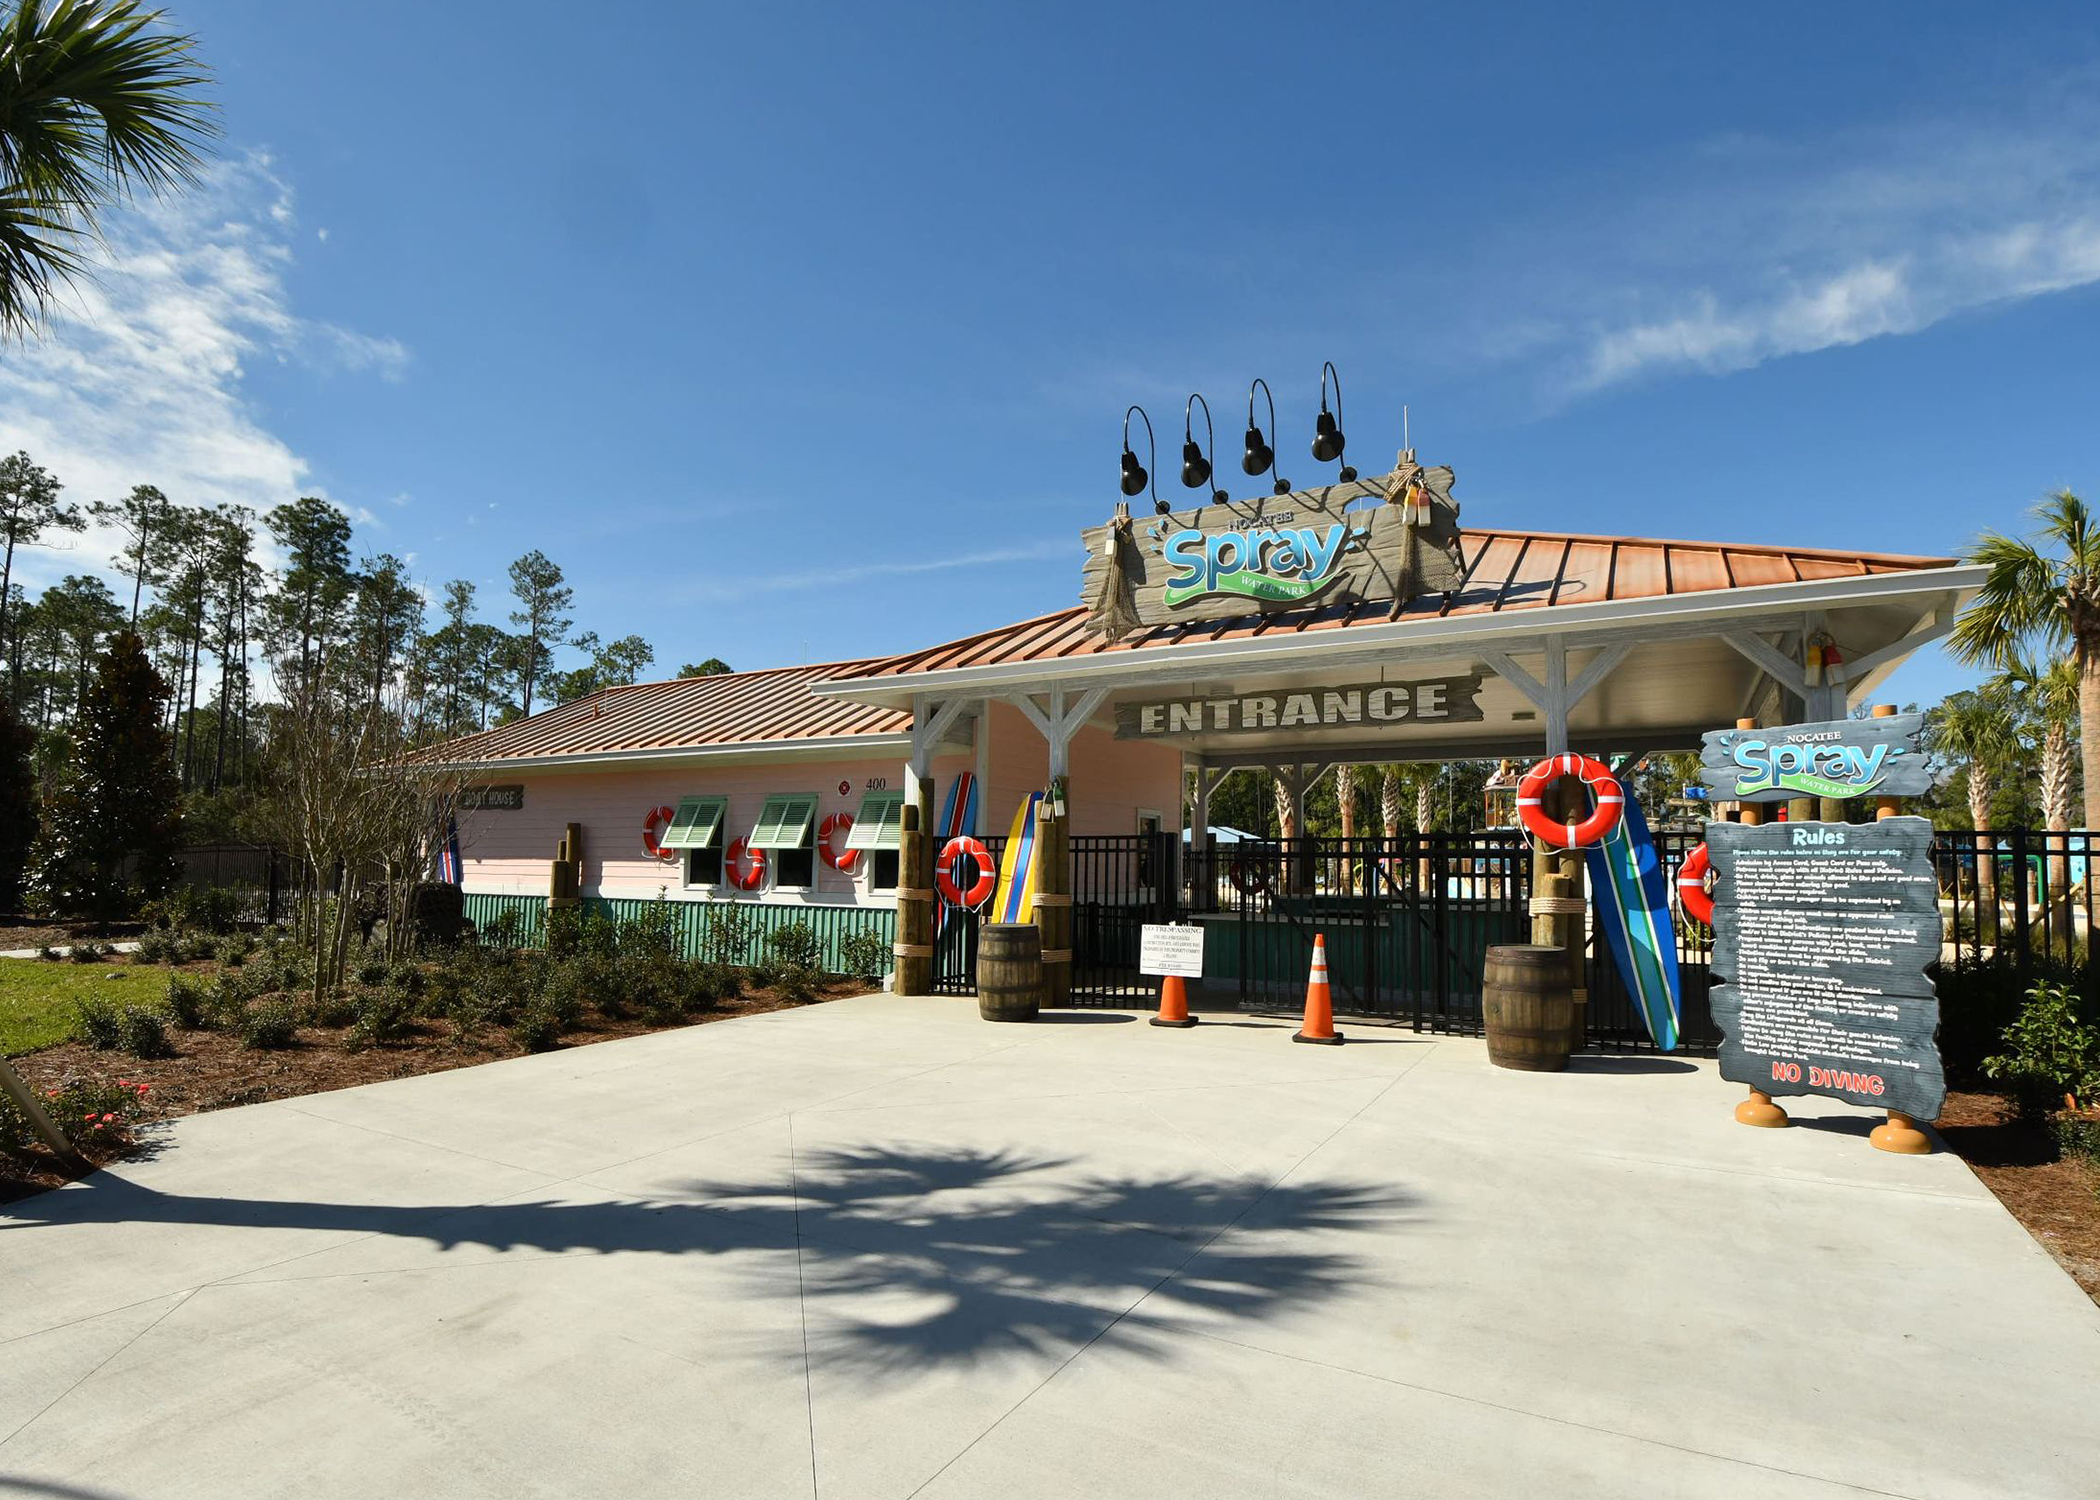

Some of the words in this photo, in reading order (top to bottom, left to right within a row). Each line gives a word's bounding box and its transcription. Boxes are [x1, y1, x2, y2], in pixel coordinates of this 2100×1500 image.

[1163, 523, 1347, 591] Spray
[1241, 575, 1276, 594] WATER
[1279, 585, 1306, 596] PARK
[1141, 684, 1449, 734] ENTRANCE
[1787, 731, 1842, 743] NOCATEE
[1734, 740, 1889, 788] Spray
[866, 778, 886, 791] 400
[1800, 777, 1831, 793] WATER
[1830, 786, 1856, 795] PARK
[489, 791, 515, 805] HOUSE
[1793, 828, 1845, 846] Rules
[1156, 926, 1202, 934] TRESPASSING
[1772, 1061, 1801, 1083] NO
[1808, 1066, 1885, 1096] DIVING
